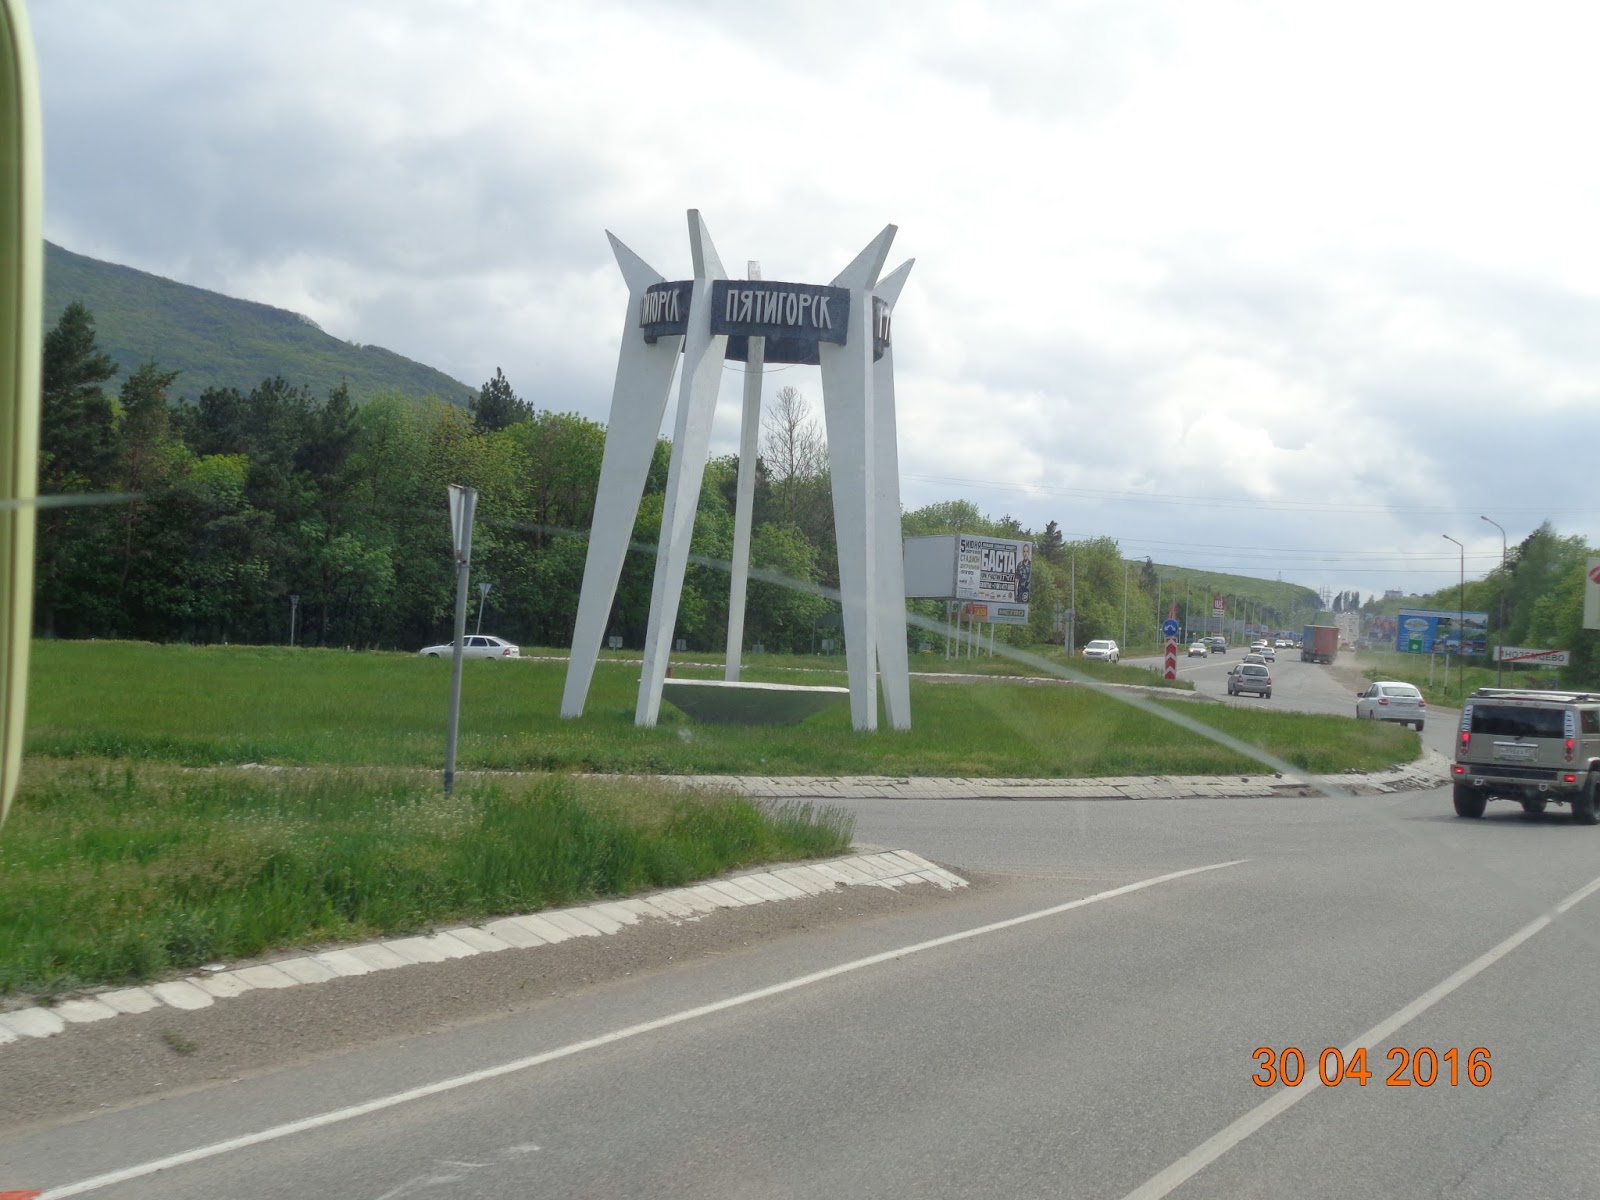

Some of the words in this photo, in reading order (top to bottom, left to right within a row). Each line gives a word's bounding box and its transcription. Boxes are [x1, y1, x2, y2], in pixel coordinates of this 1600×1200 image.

[725, 289, 832, 329] ПЯТИГОРСК
[961, 539, 966, 552] 5
[966, 540, 981, 549] ИЮНЯ
[981, 549, 1016, 573] БАСТА
[1501, 650, 1565, 662] НОЗЕМЦЕВО
